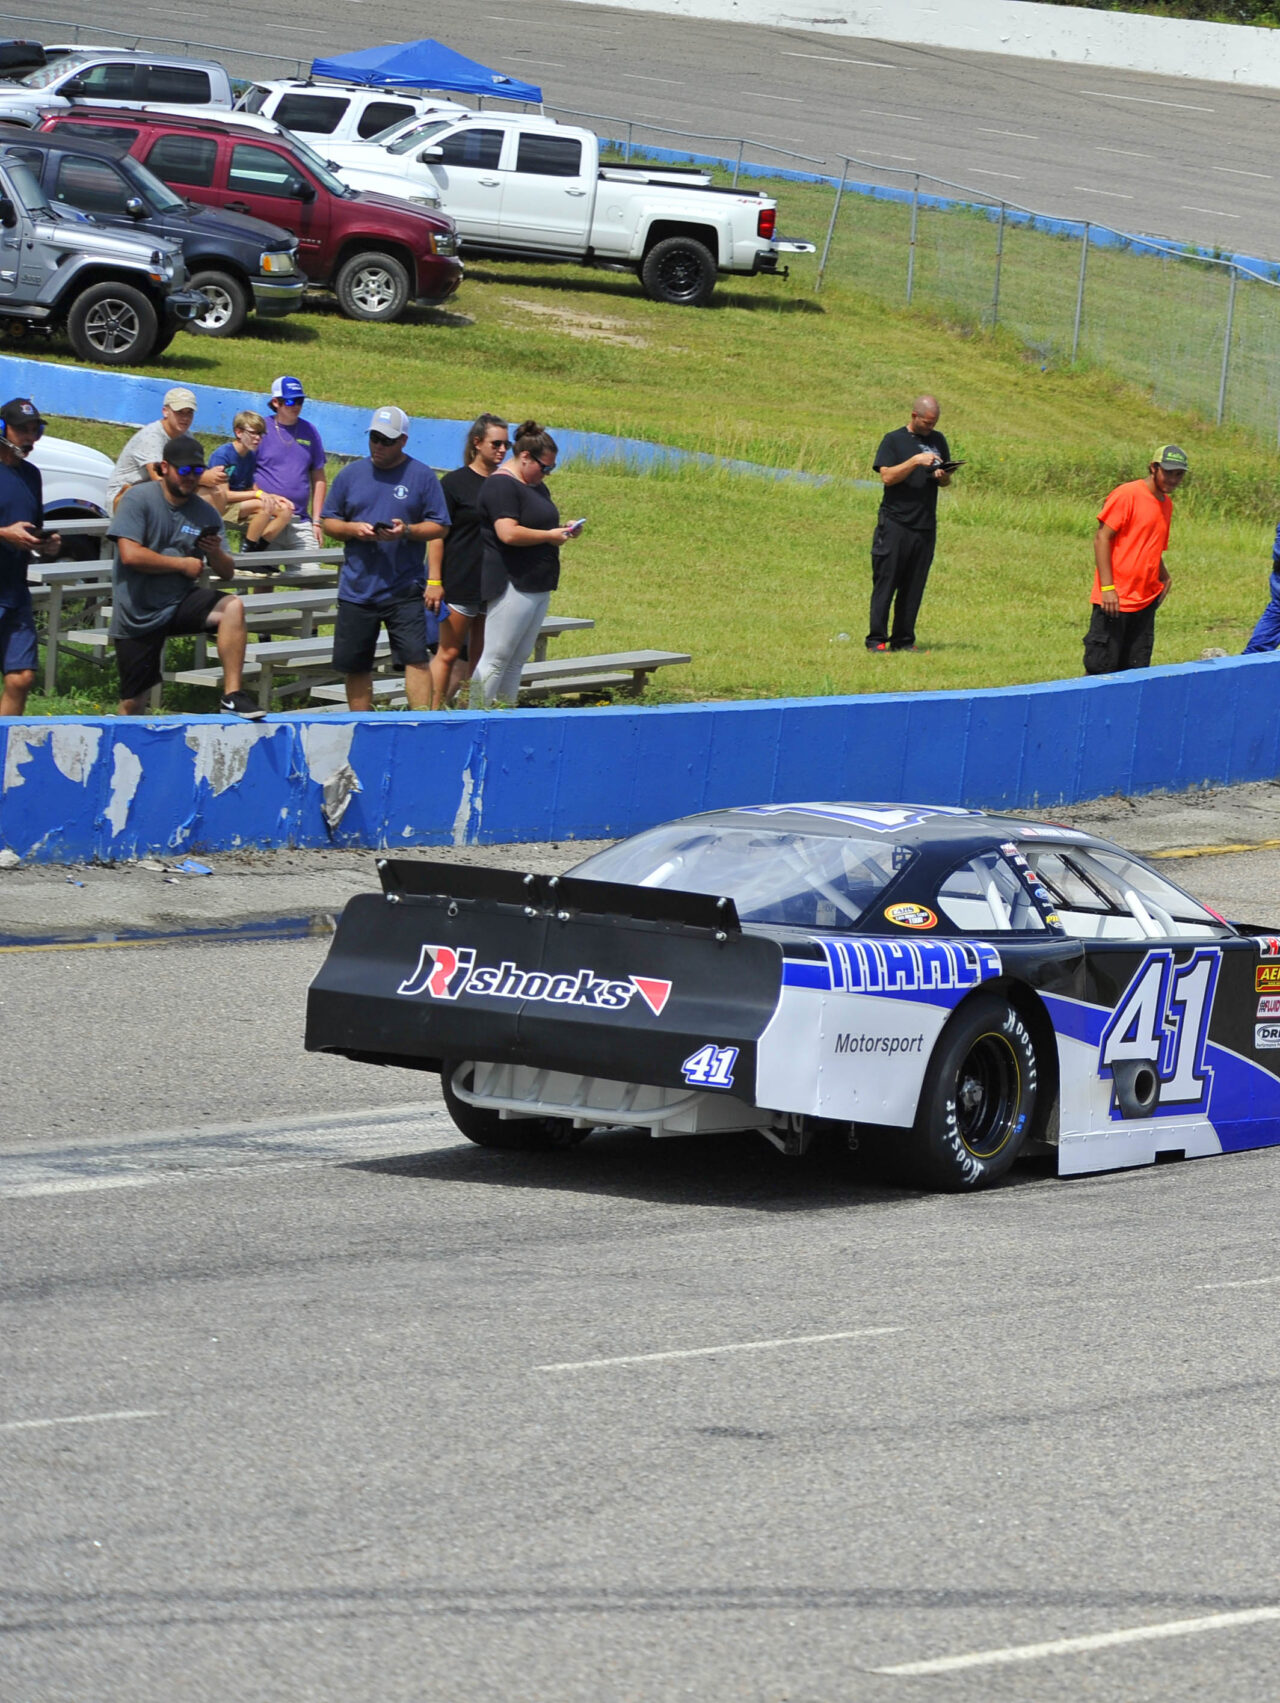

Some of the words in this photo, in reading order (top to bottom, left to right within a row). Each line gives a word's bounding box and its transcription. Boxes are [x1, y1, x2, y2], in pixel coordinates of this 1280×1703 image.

[834, 1033, 924, 1056] Motorsport
[1098, 947, 1223, 1121] 41
[682, 1045, 740, 1088] 41
